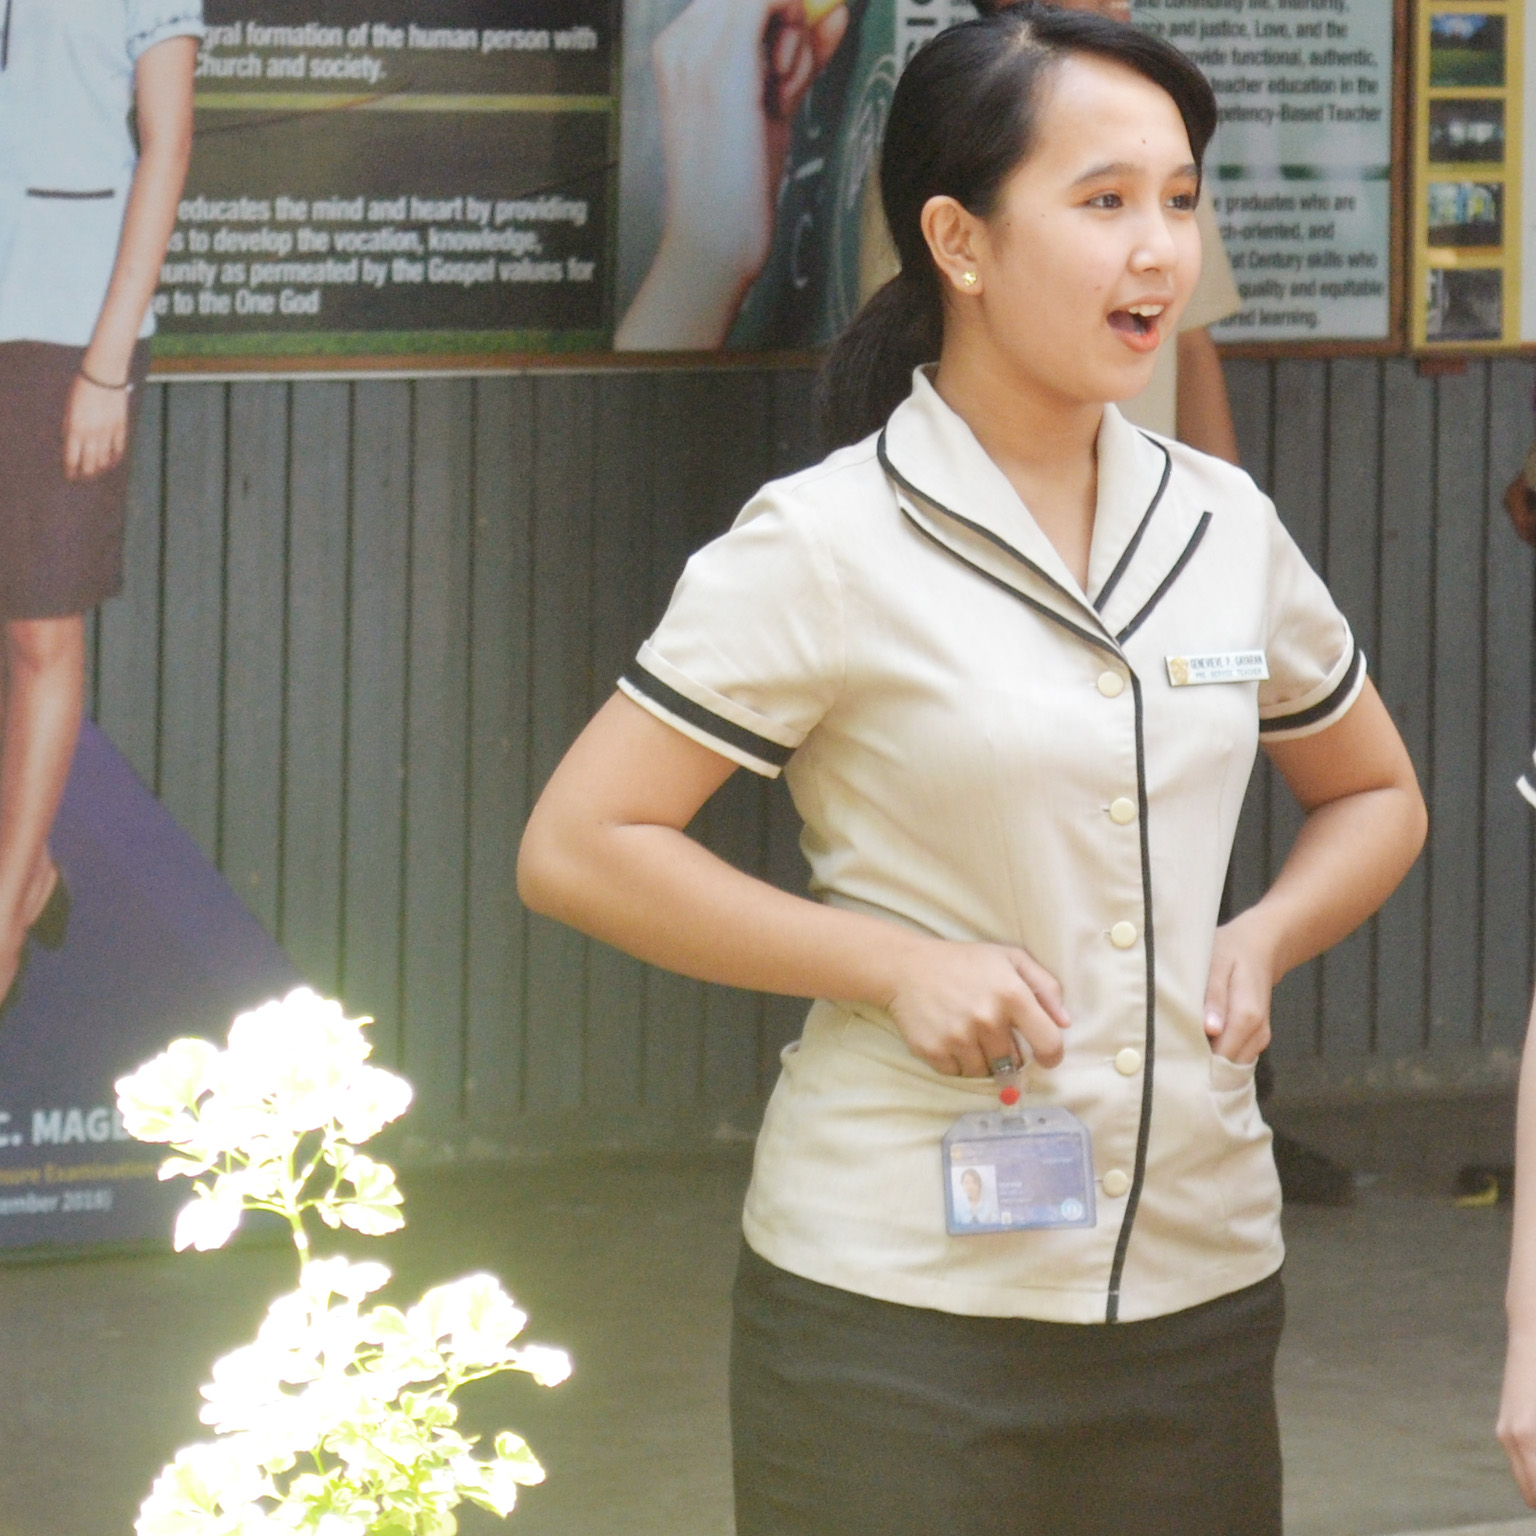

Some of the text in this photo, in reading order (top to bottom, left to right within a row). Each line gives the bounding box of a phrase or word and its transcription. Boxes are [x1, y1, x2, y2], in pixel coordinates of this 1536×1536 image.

[246, 21, 342, 48] formation
[346, 22, 370, 48] of
[373, 23, 403, 48] the
[408, 24, 480, 49] human
[481, 27, 551, 55] person
[553, 25, 598, 51] with
[266, 53, 306, 78] and
[275, 196, 308, 221] the
[312, 197, 363, 221] mind
[367, 197, 406, 221] and
[410, 197, 463, 221] heart
[466, 198, 493, 225] by
[494, 199, 589, 227] providing
[189, 229, 211, 252] to
[214, 229, 293, 257] develop
[296, 229, 329, 252] the
[220, 263, 246, 284] as
[250, 261, 359, 288] permeated
[363, 261, 388, 289] by
[392, 261, 424, 284] the
[428, 259, 495, 289] Gospel
[498, 261, 564, 284] values
[566, 261, 595, 283] for
[173, 291, 195, 314] to
[198, 290, 231, 314] the
[234, 289, 275, 314] One
[279, 289, 320, 314] God
